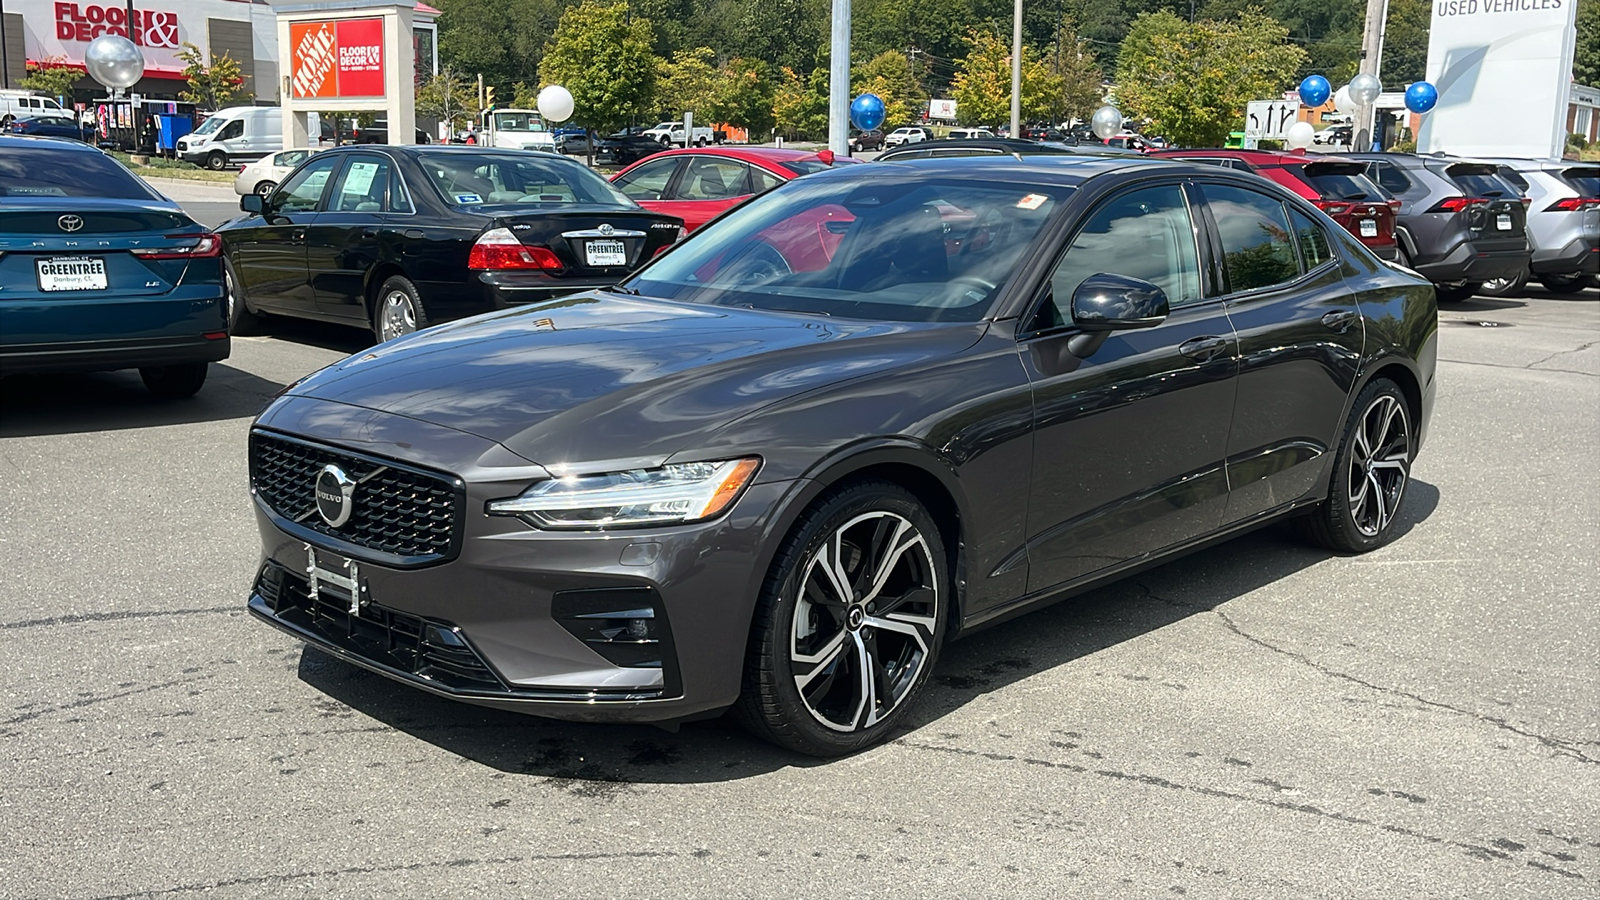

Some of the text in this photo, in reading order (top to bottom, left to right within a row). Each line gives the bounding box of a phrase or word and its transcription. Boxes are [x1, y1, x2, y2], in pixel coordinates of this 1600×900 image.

[54, 2, 142, 27] FLOOR
[1438, 0, 1562, 17] USED VEHICLES
[295, 28, 316, 61] THE
[339, 46, 367, 57] FLOOR
[293, 23, 335, 98] HOME
[340, 56, 367, 66] DECOR
[308, 49, 336, 98] DEPOT
[588, 244, 624, 254] GREENTREE
[41, 263, 103, 276] GREENTREE
[53, 275, 82, 284] Danbury,
[317, 490, 342, 503] VOLVO
